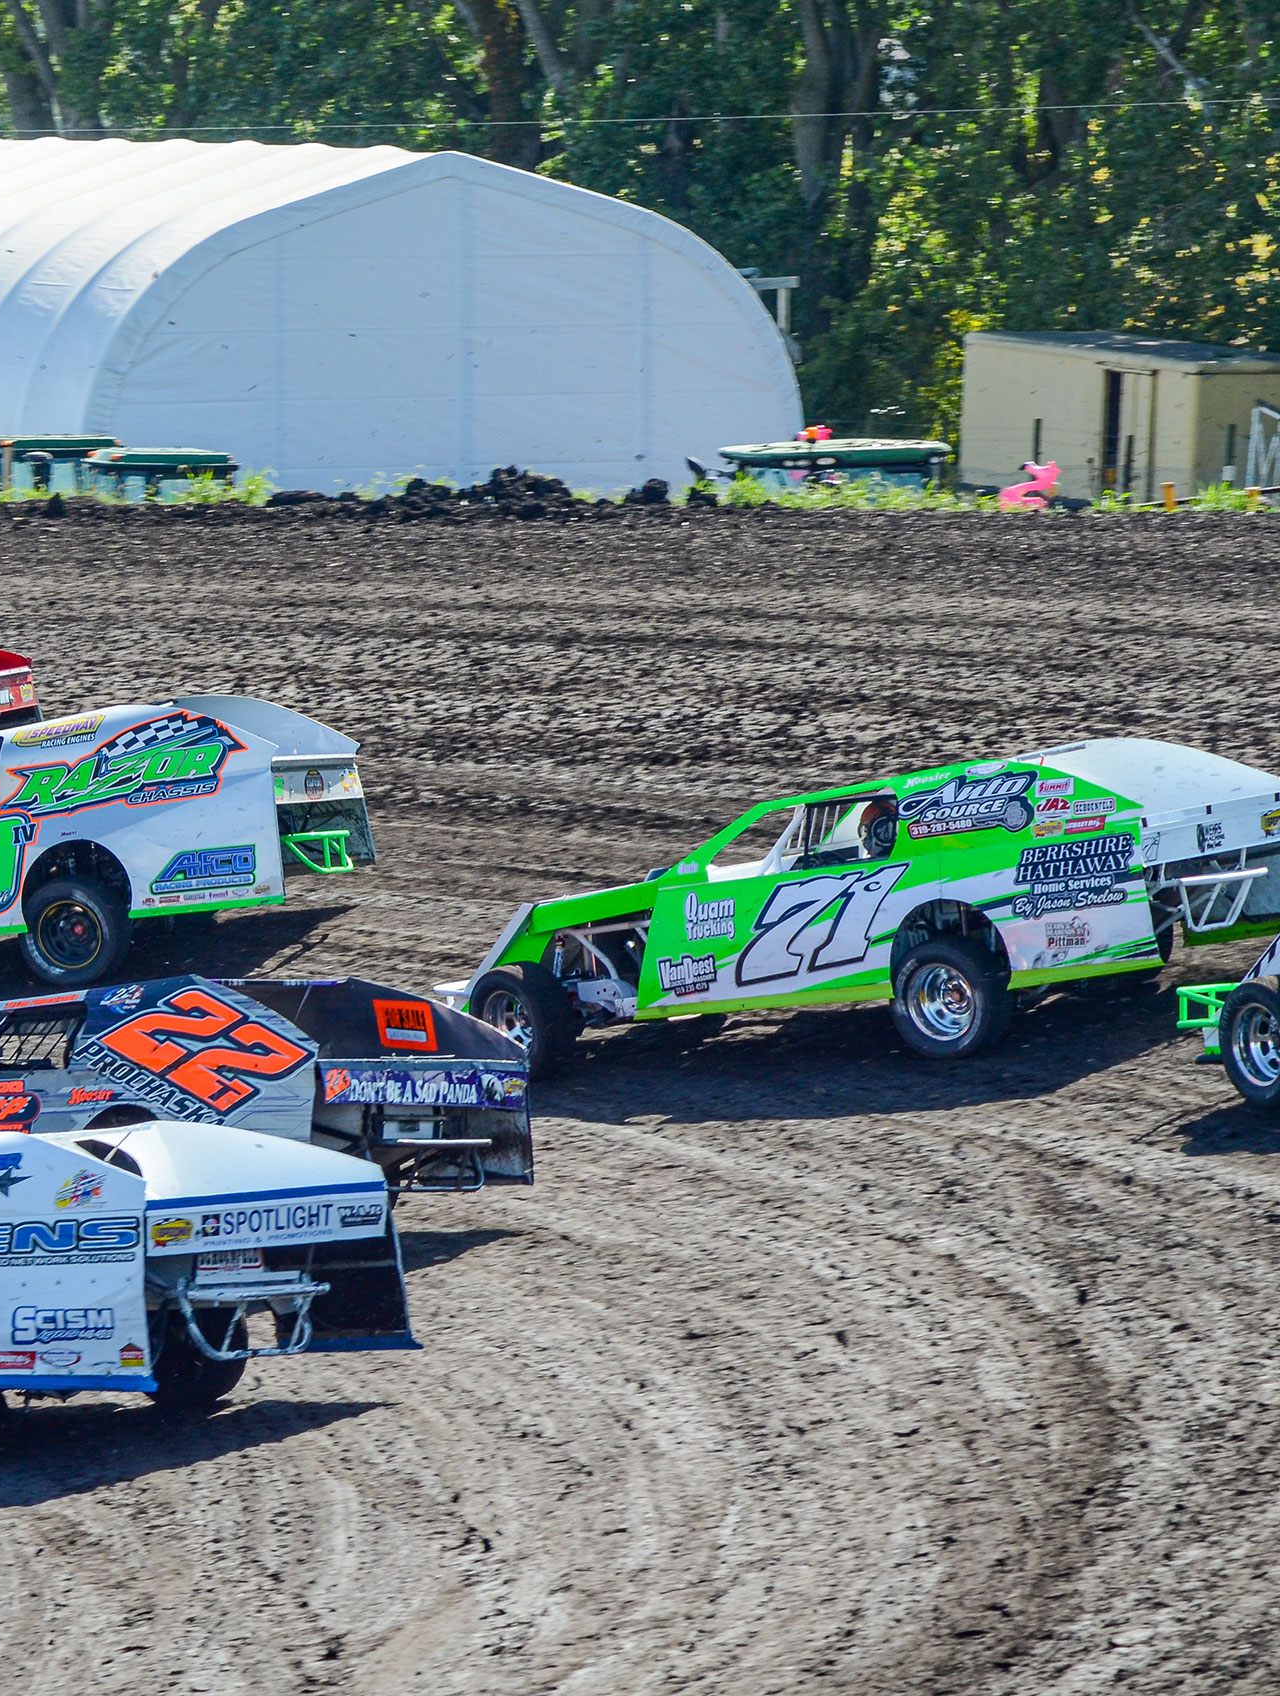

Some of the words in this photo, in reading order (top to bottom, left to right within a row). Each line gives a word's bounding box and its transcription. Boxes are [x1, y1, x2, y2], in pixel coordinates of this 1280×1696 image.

[30, 718, 96, 740] SPEEDWAY
[41, 738, 67, 749] RACING
[67, 733, 96, 745] ENGINES
[11, 740, 224, 812] RAZOR
[127, 780, 218, 805] CHASSIS
[897, 775, 1032, 819] Auto
[923, 798, 1007, 822] SOURCE
[1074, 800, 1115, 813] SCHOENFELD
[1021, 834, 1132, 865] BERKSHIRE
[1017, 853, 1131, 882] HATHAWAY
[154, 878, 193, 893] RACING
[194, 873, 252, 889] PRODUCTS
[1033, 880, 1066, 895] Home
[1067, 876, 1112, 891] Services
[683, 891, 736, 924] Quam
[1014, 898, 1035, 917] By
[1035, 894, 1071, 916] Jason
[1074, 889, 1124, 907] Strelow
[685, 918, 736, 941] Trucking
[1048, 937, 1086, 948] Pittman
[659, 957, 715, 989] VanDeest
[384, 1007, 401, 1029] FOR
[401, 1008, 426, 1030] SALE
[72, 1040, 226, 1123] PROCHASKA
[348, 1079, 385, 1101] DON'T
[385, 1080, 403, 1103] BE
[402, 1081, 415, 1103] A
[414, 1079, 439, 1103] SAD
[439, 1080, 478, 1105] PANDA
[222, 1203, 334, 1236] SPOTLIGHT
[202, 1236, 250, 1248] PRINTING
[254, 1235, 263, 1244] &
[267, 1228, 334, 1242] PROMOTIONS
[9, 1255, 69, 1267] NETWORK
[69, 1252, 135, 1265] SOLUTIONS
[12, 1305, 116, 1345] SCISM
